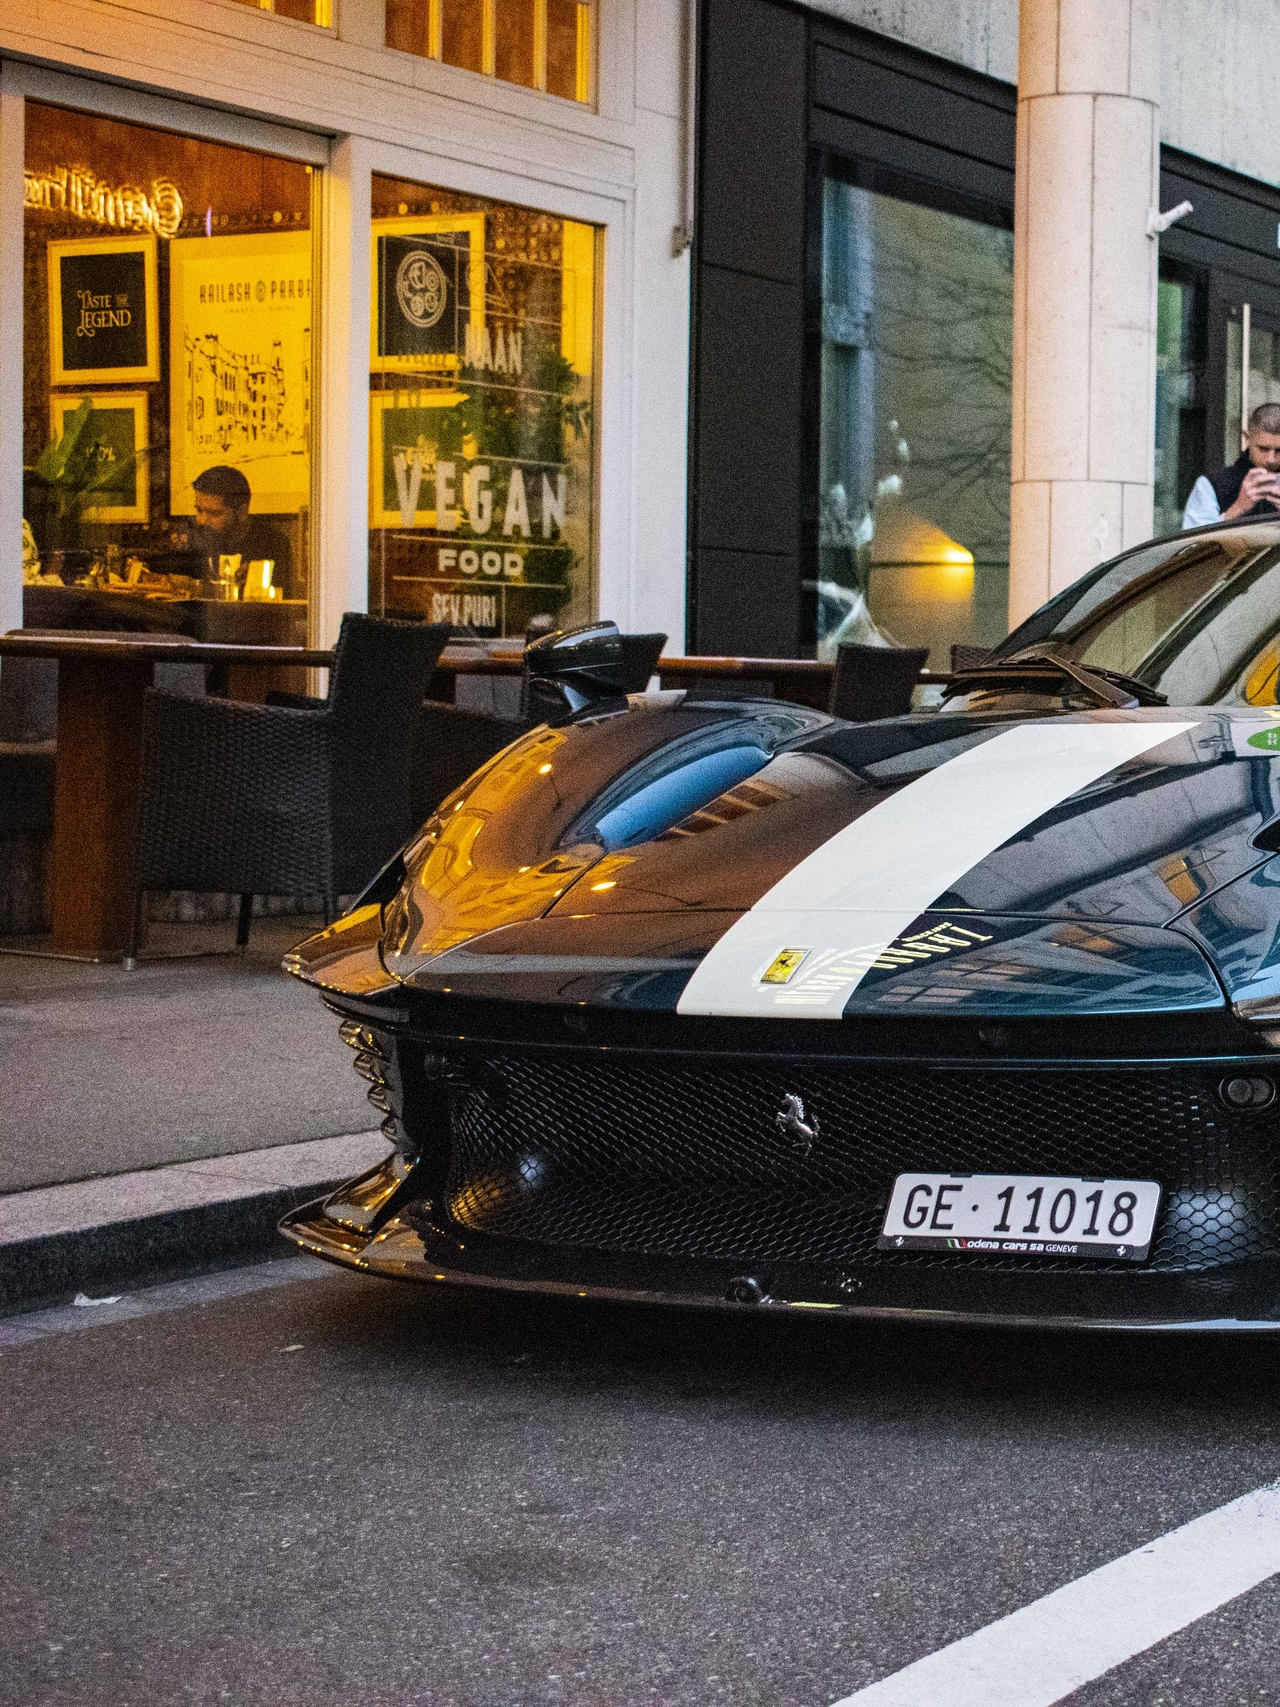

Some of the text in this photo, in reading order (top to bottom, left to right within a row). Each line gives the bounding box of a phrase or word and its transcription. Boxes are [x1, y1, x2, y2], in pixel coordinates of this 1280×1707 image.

[77, 290, 112, 309] TASTE
[200, 282, 251, 303] KAILASH
[77, 309, 132, 337] LEGEND
[464, 323, 523, 375] NAAN
[393, 455, 567, 538] VEGAN
[438, 549, 525, 576] FOOD
[902, 1184, 1138, 1236] GE 11018
[1002, 1242, 1028, 1251] cars
[1030, 1243, 1045, 1251] sa
[1046, 1243, 1078, 1253] GENEVE
